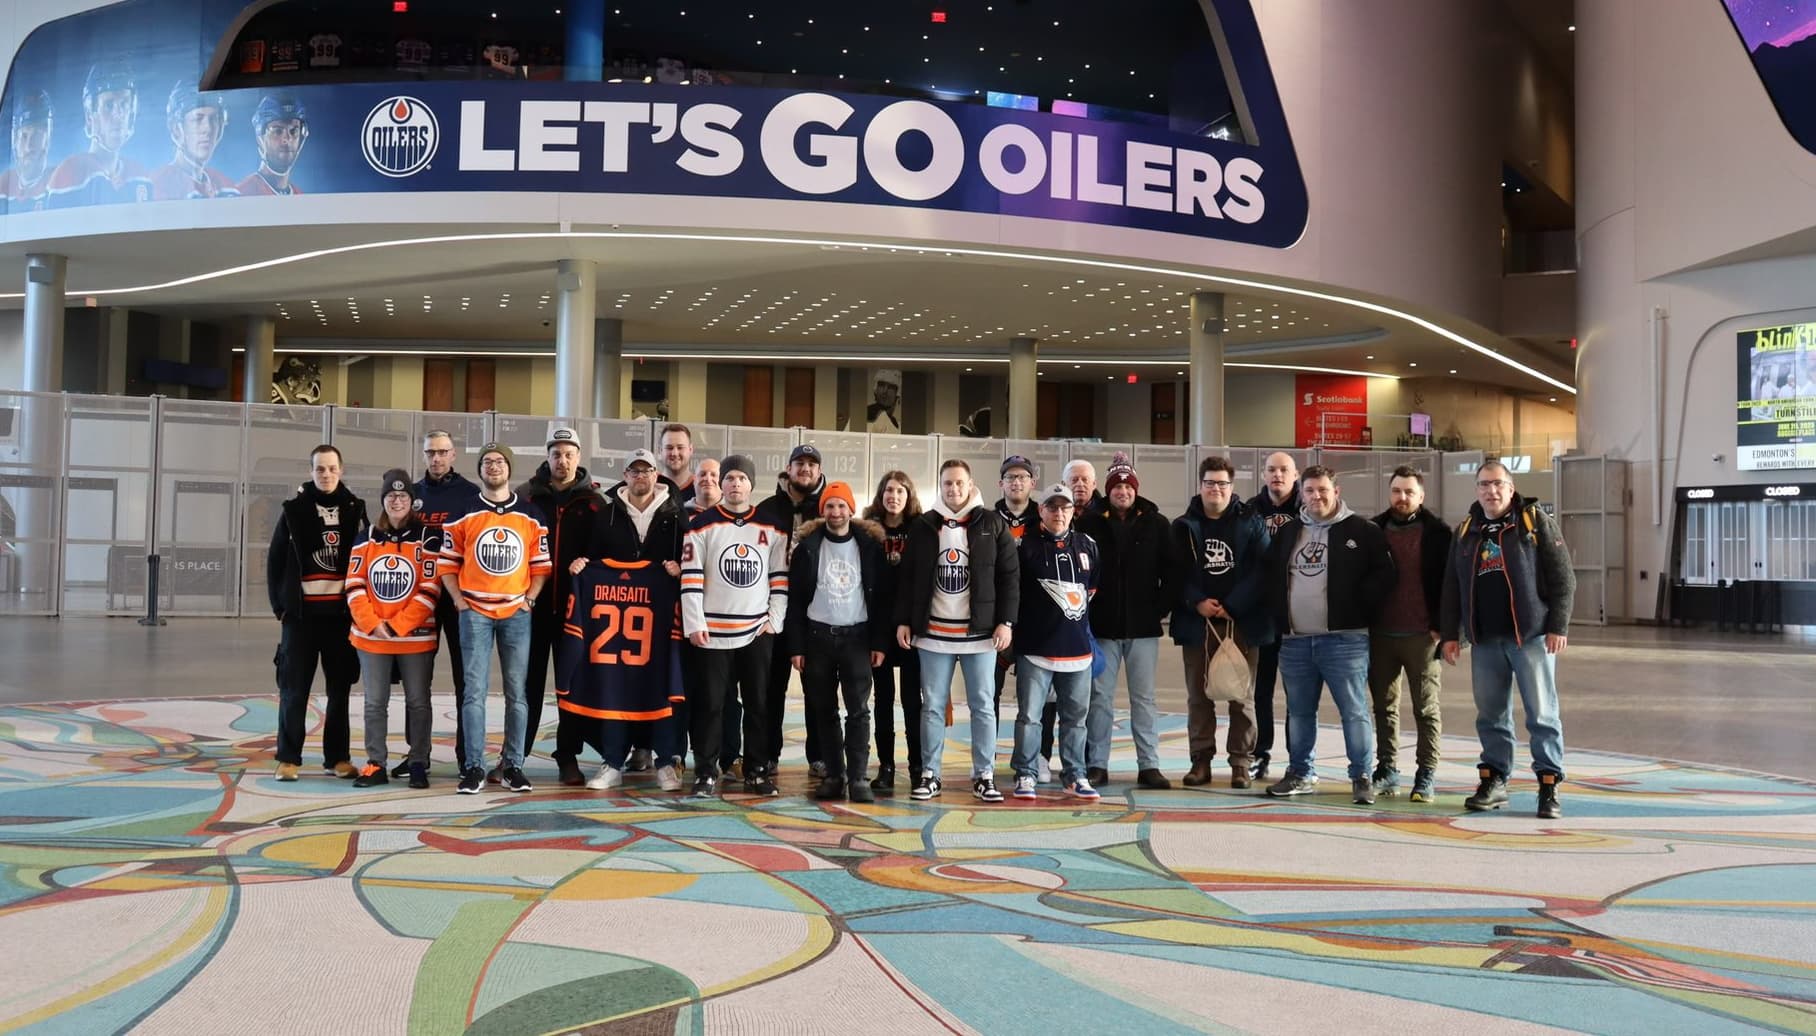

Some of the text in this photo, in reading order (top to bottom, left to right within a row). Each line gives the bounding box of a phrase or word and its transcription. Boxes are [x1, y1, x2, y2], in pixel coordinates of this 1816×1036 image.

[371, 126, 429, 162] OILERS
[459, 92, 1266, 225] LET'S GO OILERS
[1754, 324, 1816, 352] blink-1
[1752, 448, 1794, 459] EDMONTON'S
[834, 455, 857, 473] 132
[1688, 489, 1714, 498] CLOSED
[1765, 486, 1800, 496] CLOSED
[757, 529, 769, 546] A
[482, 543, 518, 563] OILERS
[187, 561, 221, 571] PLACE
[352, 557, 362, 574] 7
[424, 560, 435, 578] 9
[724, 559, 759, 578] OILERS
[373, 571, 409, 591] OILERS
[594, 584, 651, 604] DRAISAITL
[589, 603, 654, 667] 29
